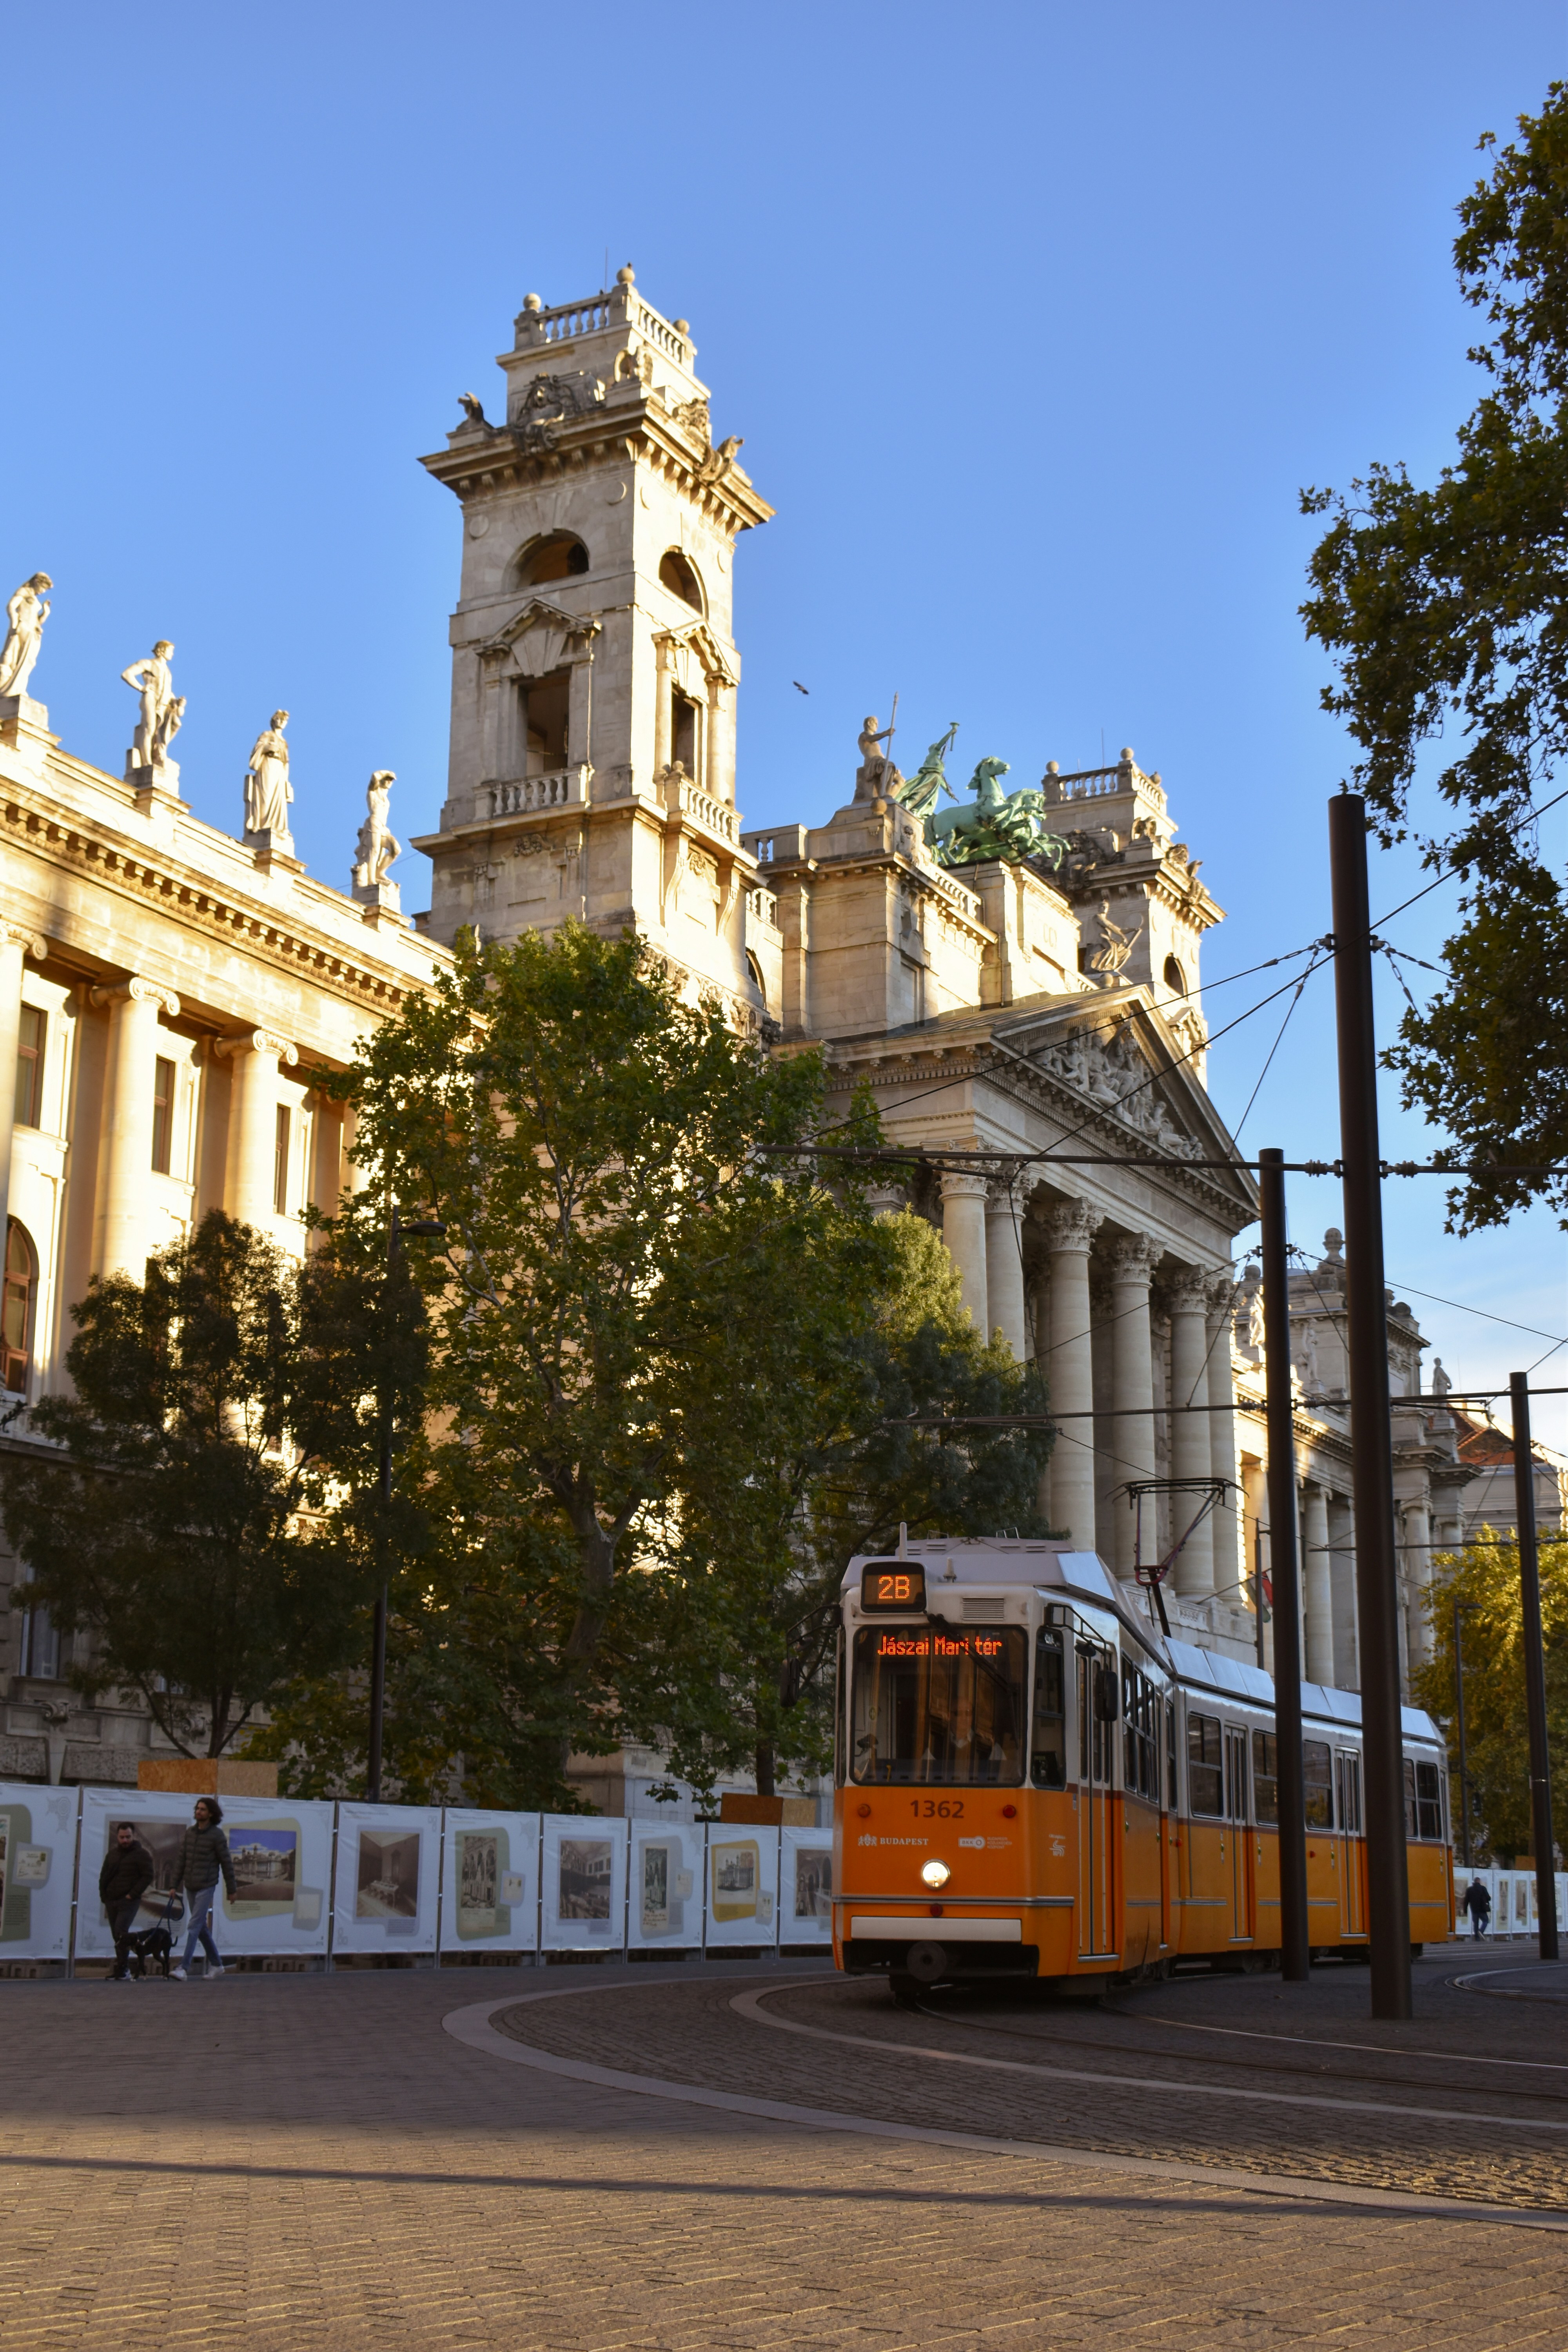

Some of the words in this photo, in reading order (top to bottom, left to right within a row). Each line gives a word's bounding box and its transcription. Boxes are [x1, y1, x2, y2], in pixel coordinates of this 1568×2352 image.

[879, 1575, 909, 1599] 2B
[877, 1636, 929, 1655] Jászai
[935, 1636, 969, 1655] Mari
[975, 1636, 1002, 1655] tér
[910, 1800, 964, 1818] 1362
[880, 1837, 929, 1846] BUDAPEST
